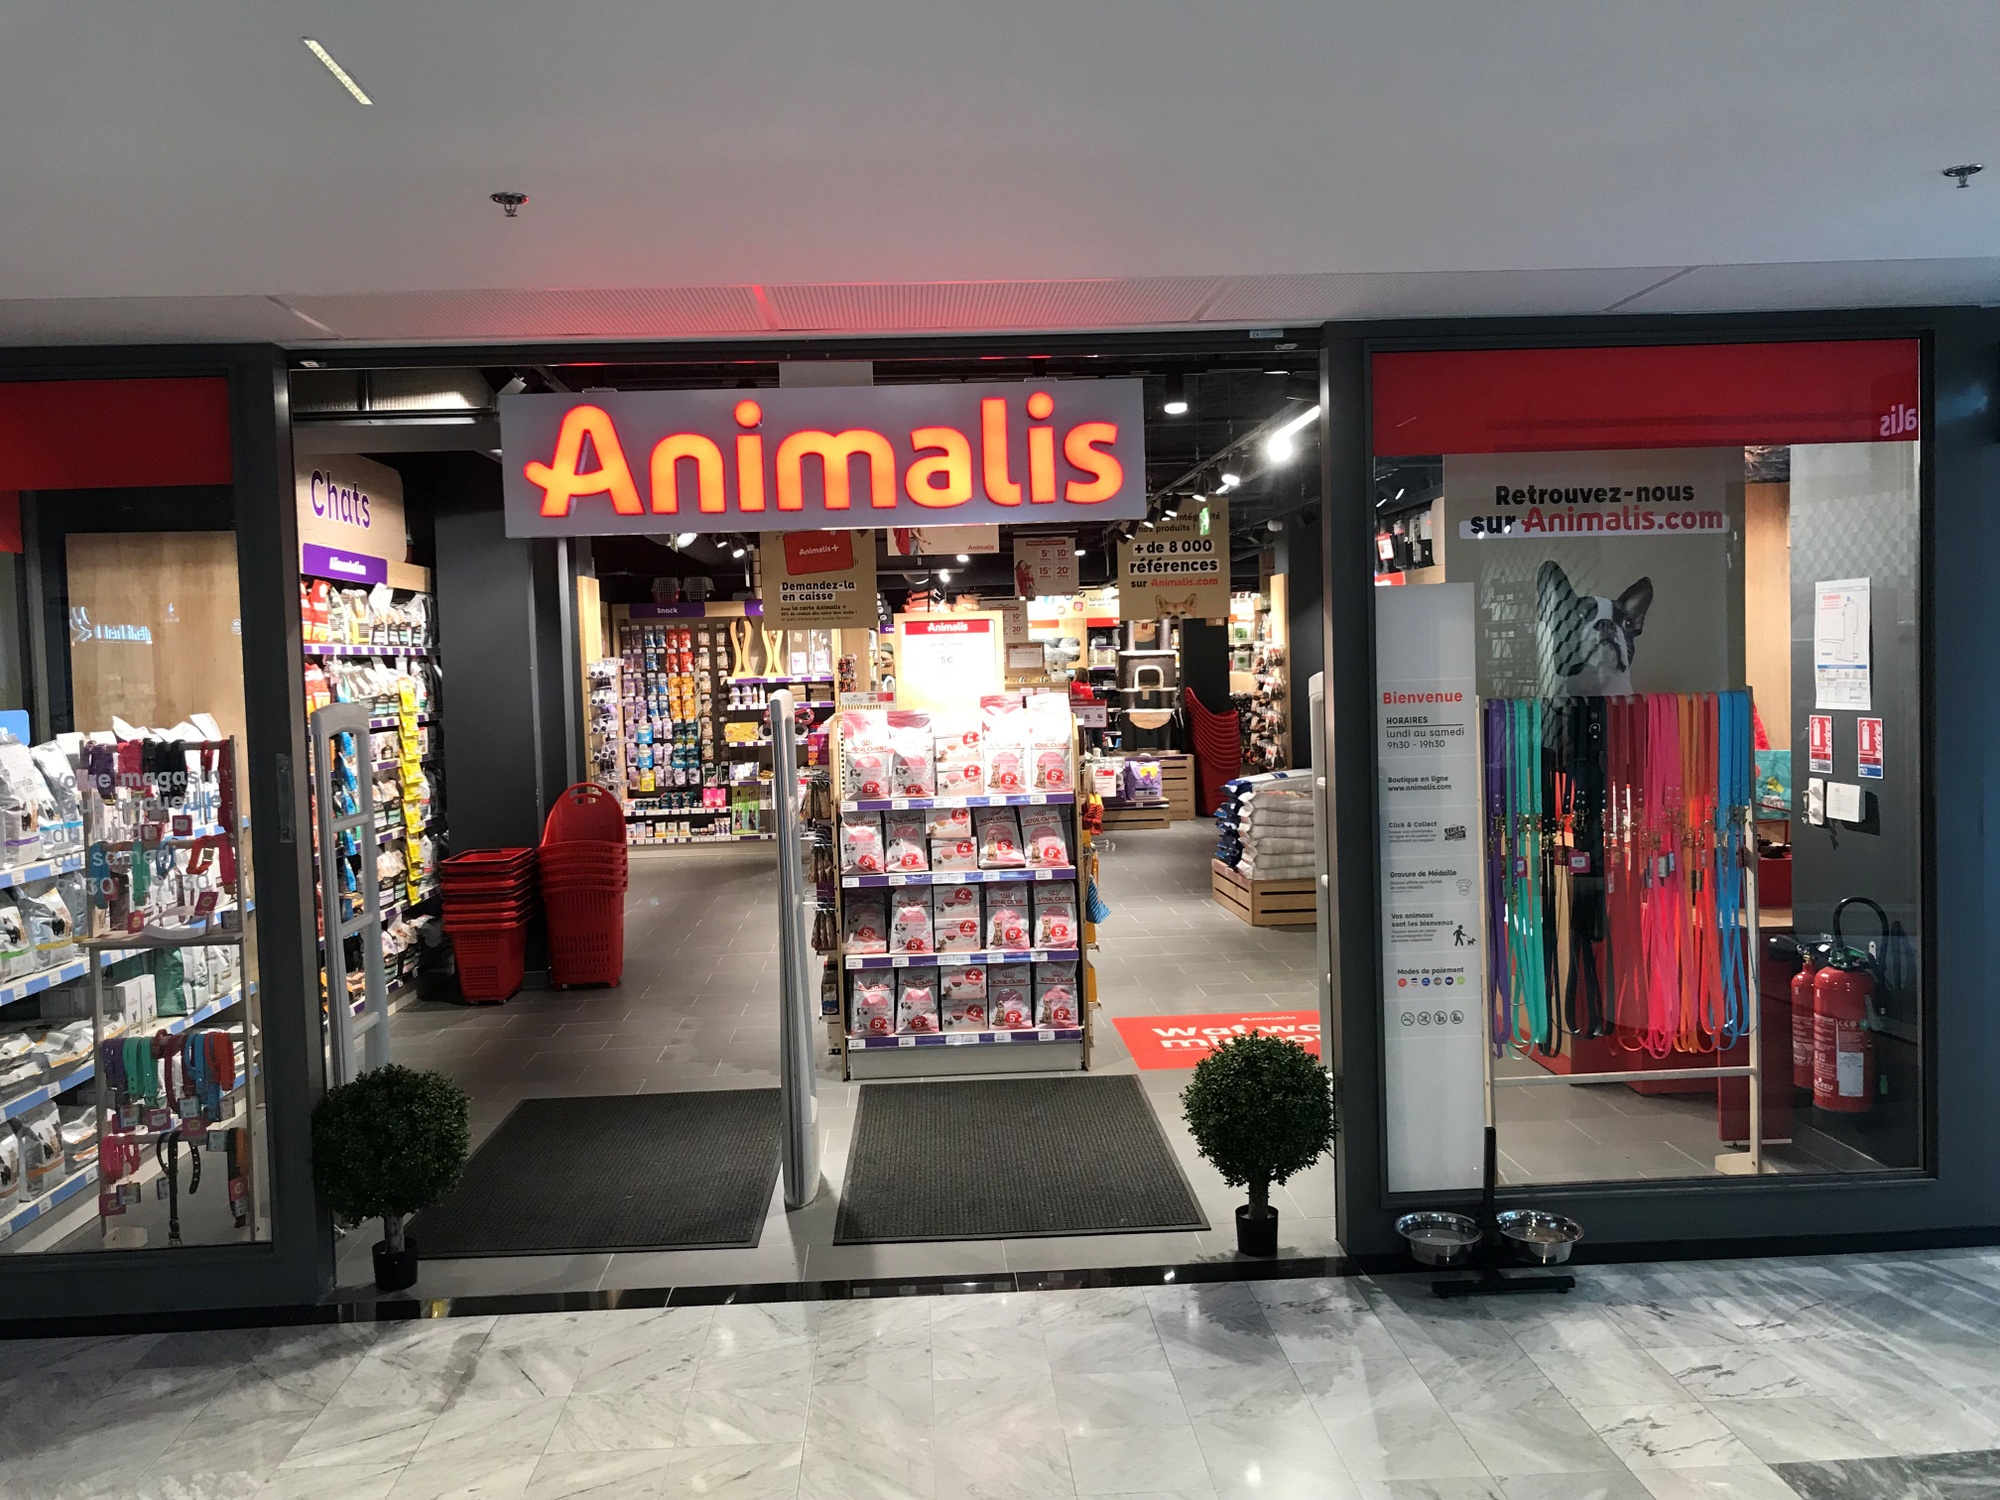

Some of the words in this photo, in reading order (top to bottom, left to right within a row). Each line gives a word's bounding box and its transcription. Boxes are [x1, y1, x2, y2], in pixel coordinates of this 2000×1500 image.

[523, 391, 1124, 517] Animalis
[310, 468, 371, 529] Chats
[1495, 484, 1695, 506] Retrouvez-nous
[1470, 512, 1516, 535] sur
[1521, 505, 1723, 533] Animalis.com
[1155, 524, 1190, 534] produits
[1134, 544, 1144, 554] +
[1146, 541, 1165, 553] de
[1169, 540, 1178, 553] 8
[1182, 540, 1212, 552] 000
[1130, 557, 1218, 573] références
[781, 580, 855, 592] Demandez-la
[1130, 580, 1147, 588] sur
[1151, 577, 1218, 587] Animalis.com
[781, 593, 796, 601] en
[799, 591, 834, 601] caisse
[656, 606, 679, 614] Snack
[927, 621, 969, 633] Animalis
[1382, 691, 1463, 705] Bienvenue
[1386, 716, 1429, 725] HORAIRES
[1386, 729, 1411, 738] lundi
[1413, 730, 1426, 738] au
[1429, 727, 1465, 737] samedi
[1387, 740, 1410, 749] 9h30
[1419, 740, 1446, 749] 19h30
[120, 766, 220, 792] magasin
[1387, 776, 1419, 784] Boutique
[1387, 784, 1452, 792] www.animalis.com
[1428, 869, 1457, 877] Médaille
[56, 876, 115, 896] 930
[1431, 966, 1464, 976] paiement
